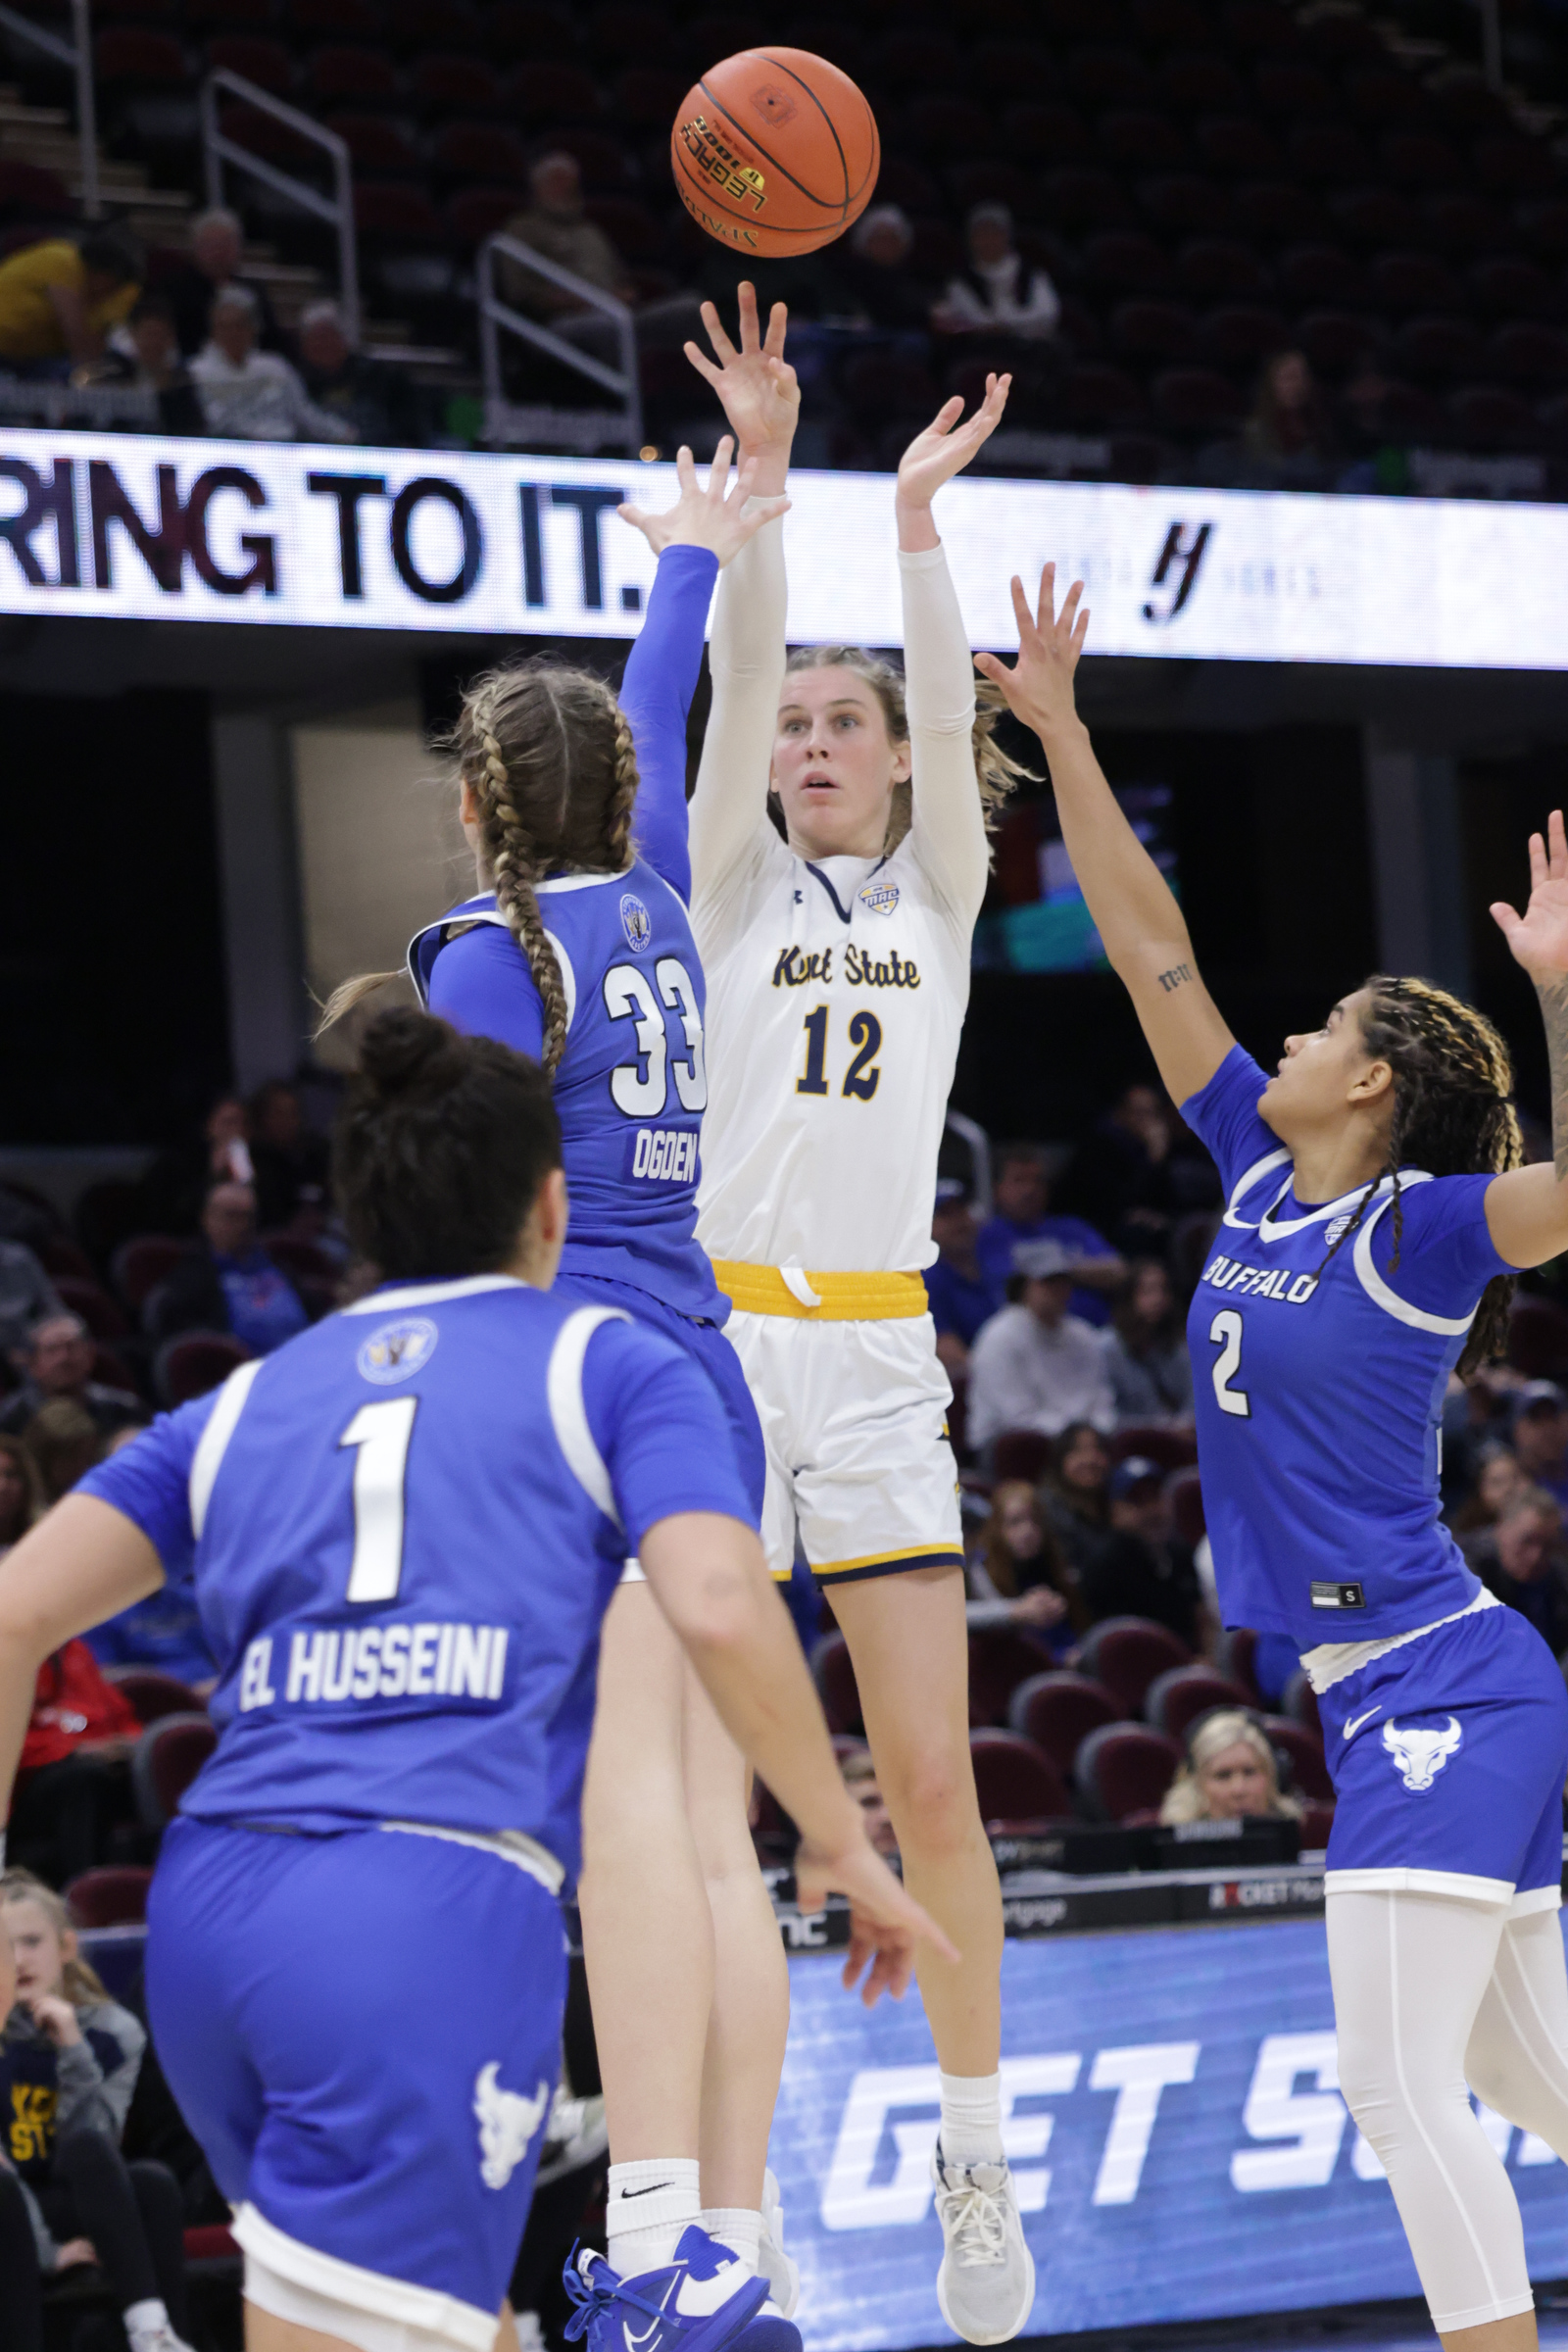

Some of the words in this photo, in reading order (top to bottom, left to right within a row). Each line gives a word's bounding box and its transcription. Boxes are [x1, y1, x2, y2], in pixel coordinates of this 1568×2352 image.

[679, 122, 768, 214] LEGACY
[306, 470, 483, 605] TO
[518, 481, 640, 611] IT.
[864, 890, 901, 907] MAC
[845, 943, 921, 990] State
[603, 956, 708, 1118] 33
[795, 1003, 883, 1103] 12
[632, 1128, 698, 1184] OGDEN
[1200, 1254, 1320, 1304] BUFFALO
[1208, 1308, 1250, 1418] 2
[337, 1395, 420, 1605] 1
[1346, 1590, 1356, 1602] S
[240, 1638, 275, 1713] EL
[286, 1622, 510, 1703] HUSSEINI
[820, 2040, 1201, 2231] GET
